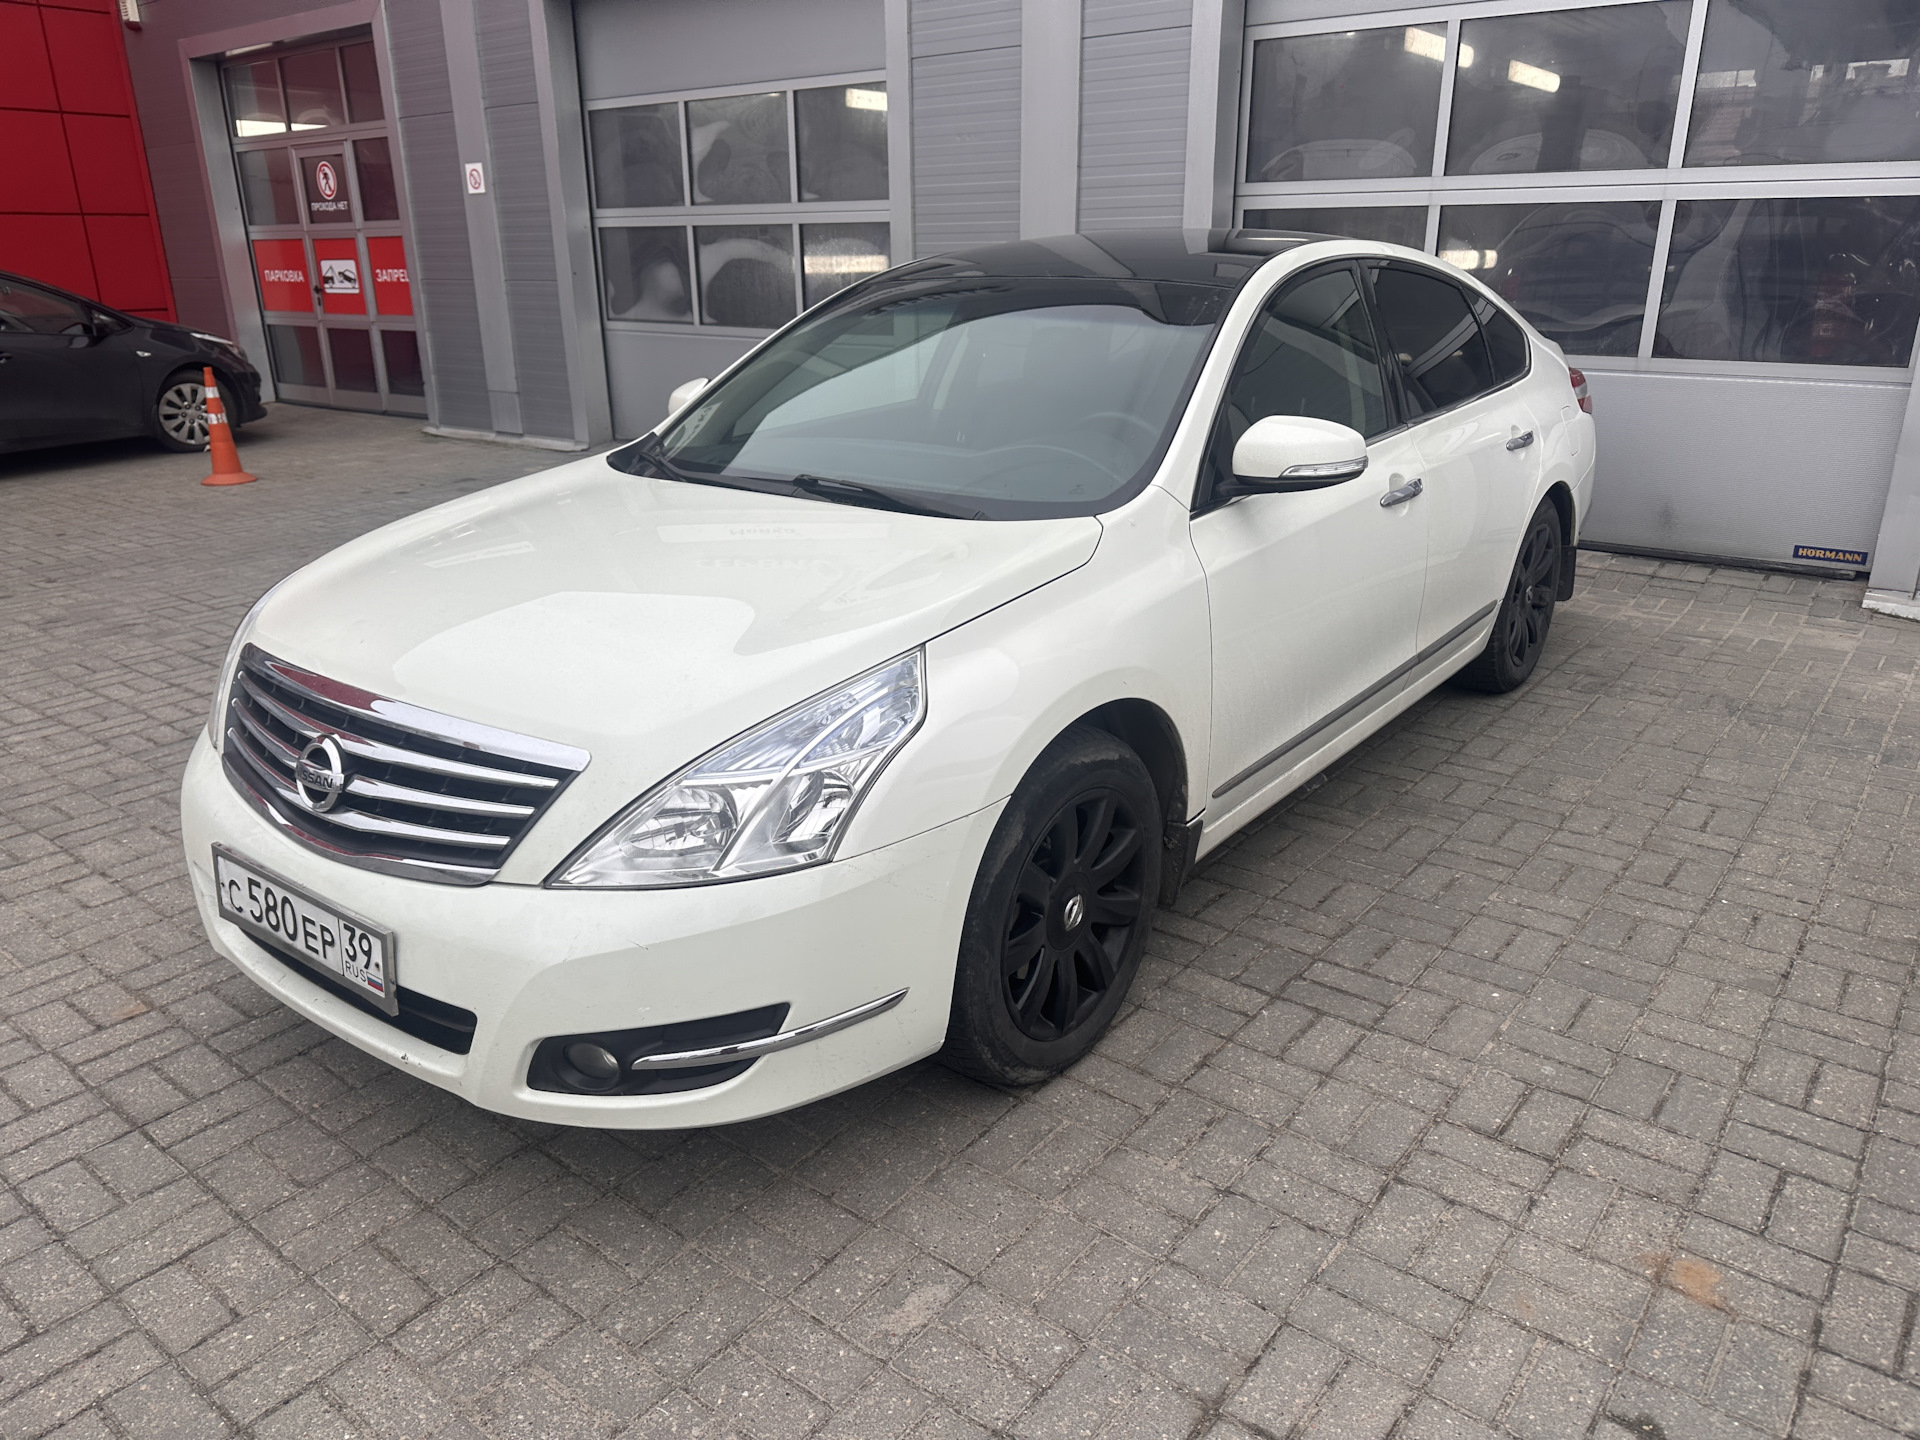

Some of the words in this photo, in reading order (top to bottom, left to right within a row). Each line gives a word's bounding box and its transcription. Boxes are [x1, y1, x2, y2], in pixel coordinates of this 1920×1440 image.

[337, 200, 348, 210] НЕТ
[264, 269, 304, 282] ПАРКОВКА
[345, 960, 366, 983] RUS
